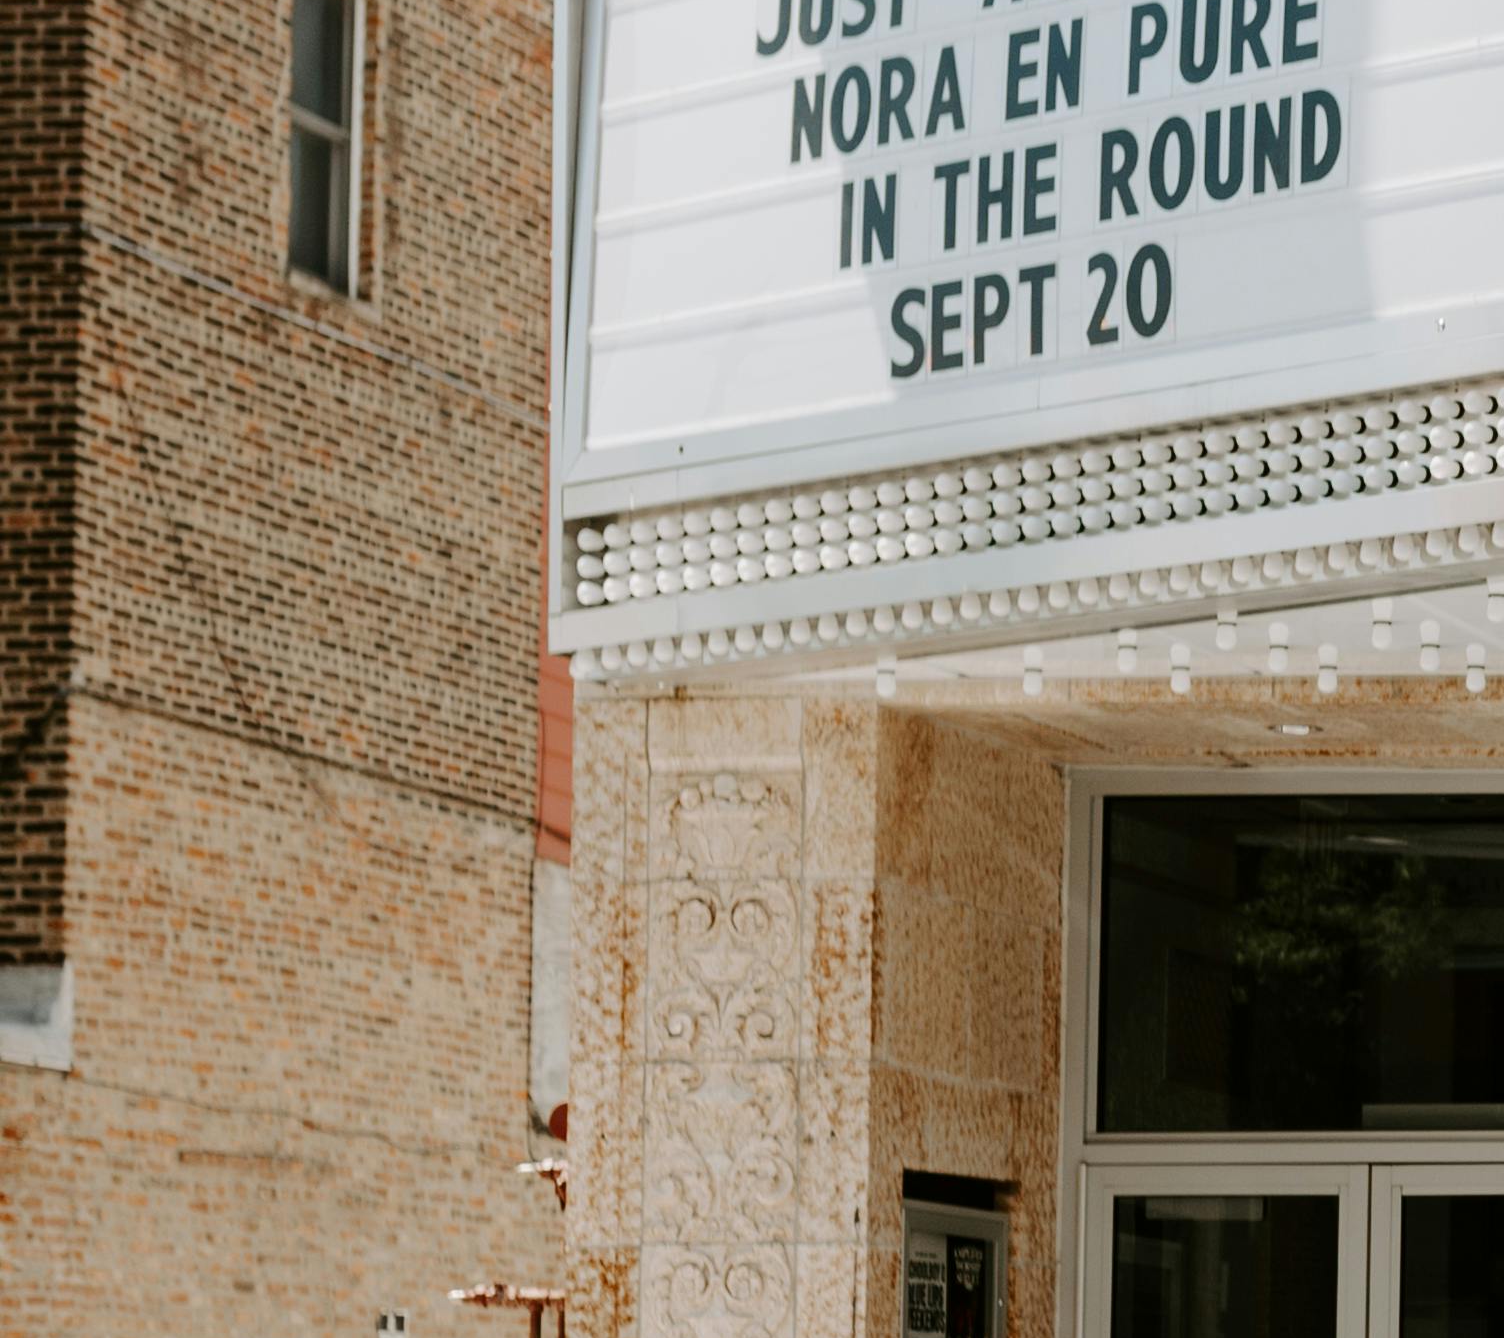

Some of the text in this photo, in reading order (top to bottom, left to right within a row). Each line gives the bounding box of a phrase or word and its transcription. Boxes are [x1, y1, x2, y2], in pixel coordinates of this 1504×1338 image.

[791, 45, 965, 162] NORA
[1005, 18, 1084, 121] EN
[840, 89, 1342, 268] IN THE ROUND
[890, 243, 1172, 379] SEPT 20
